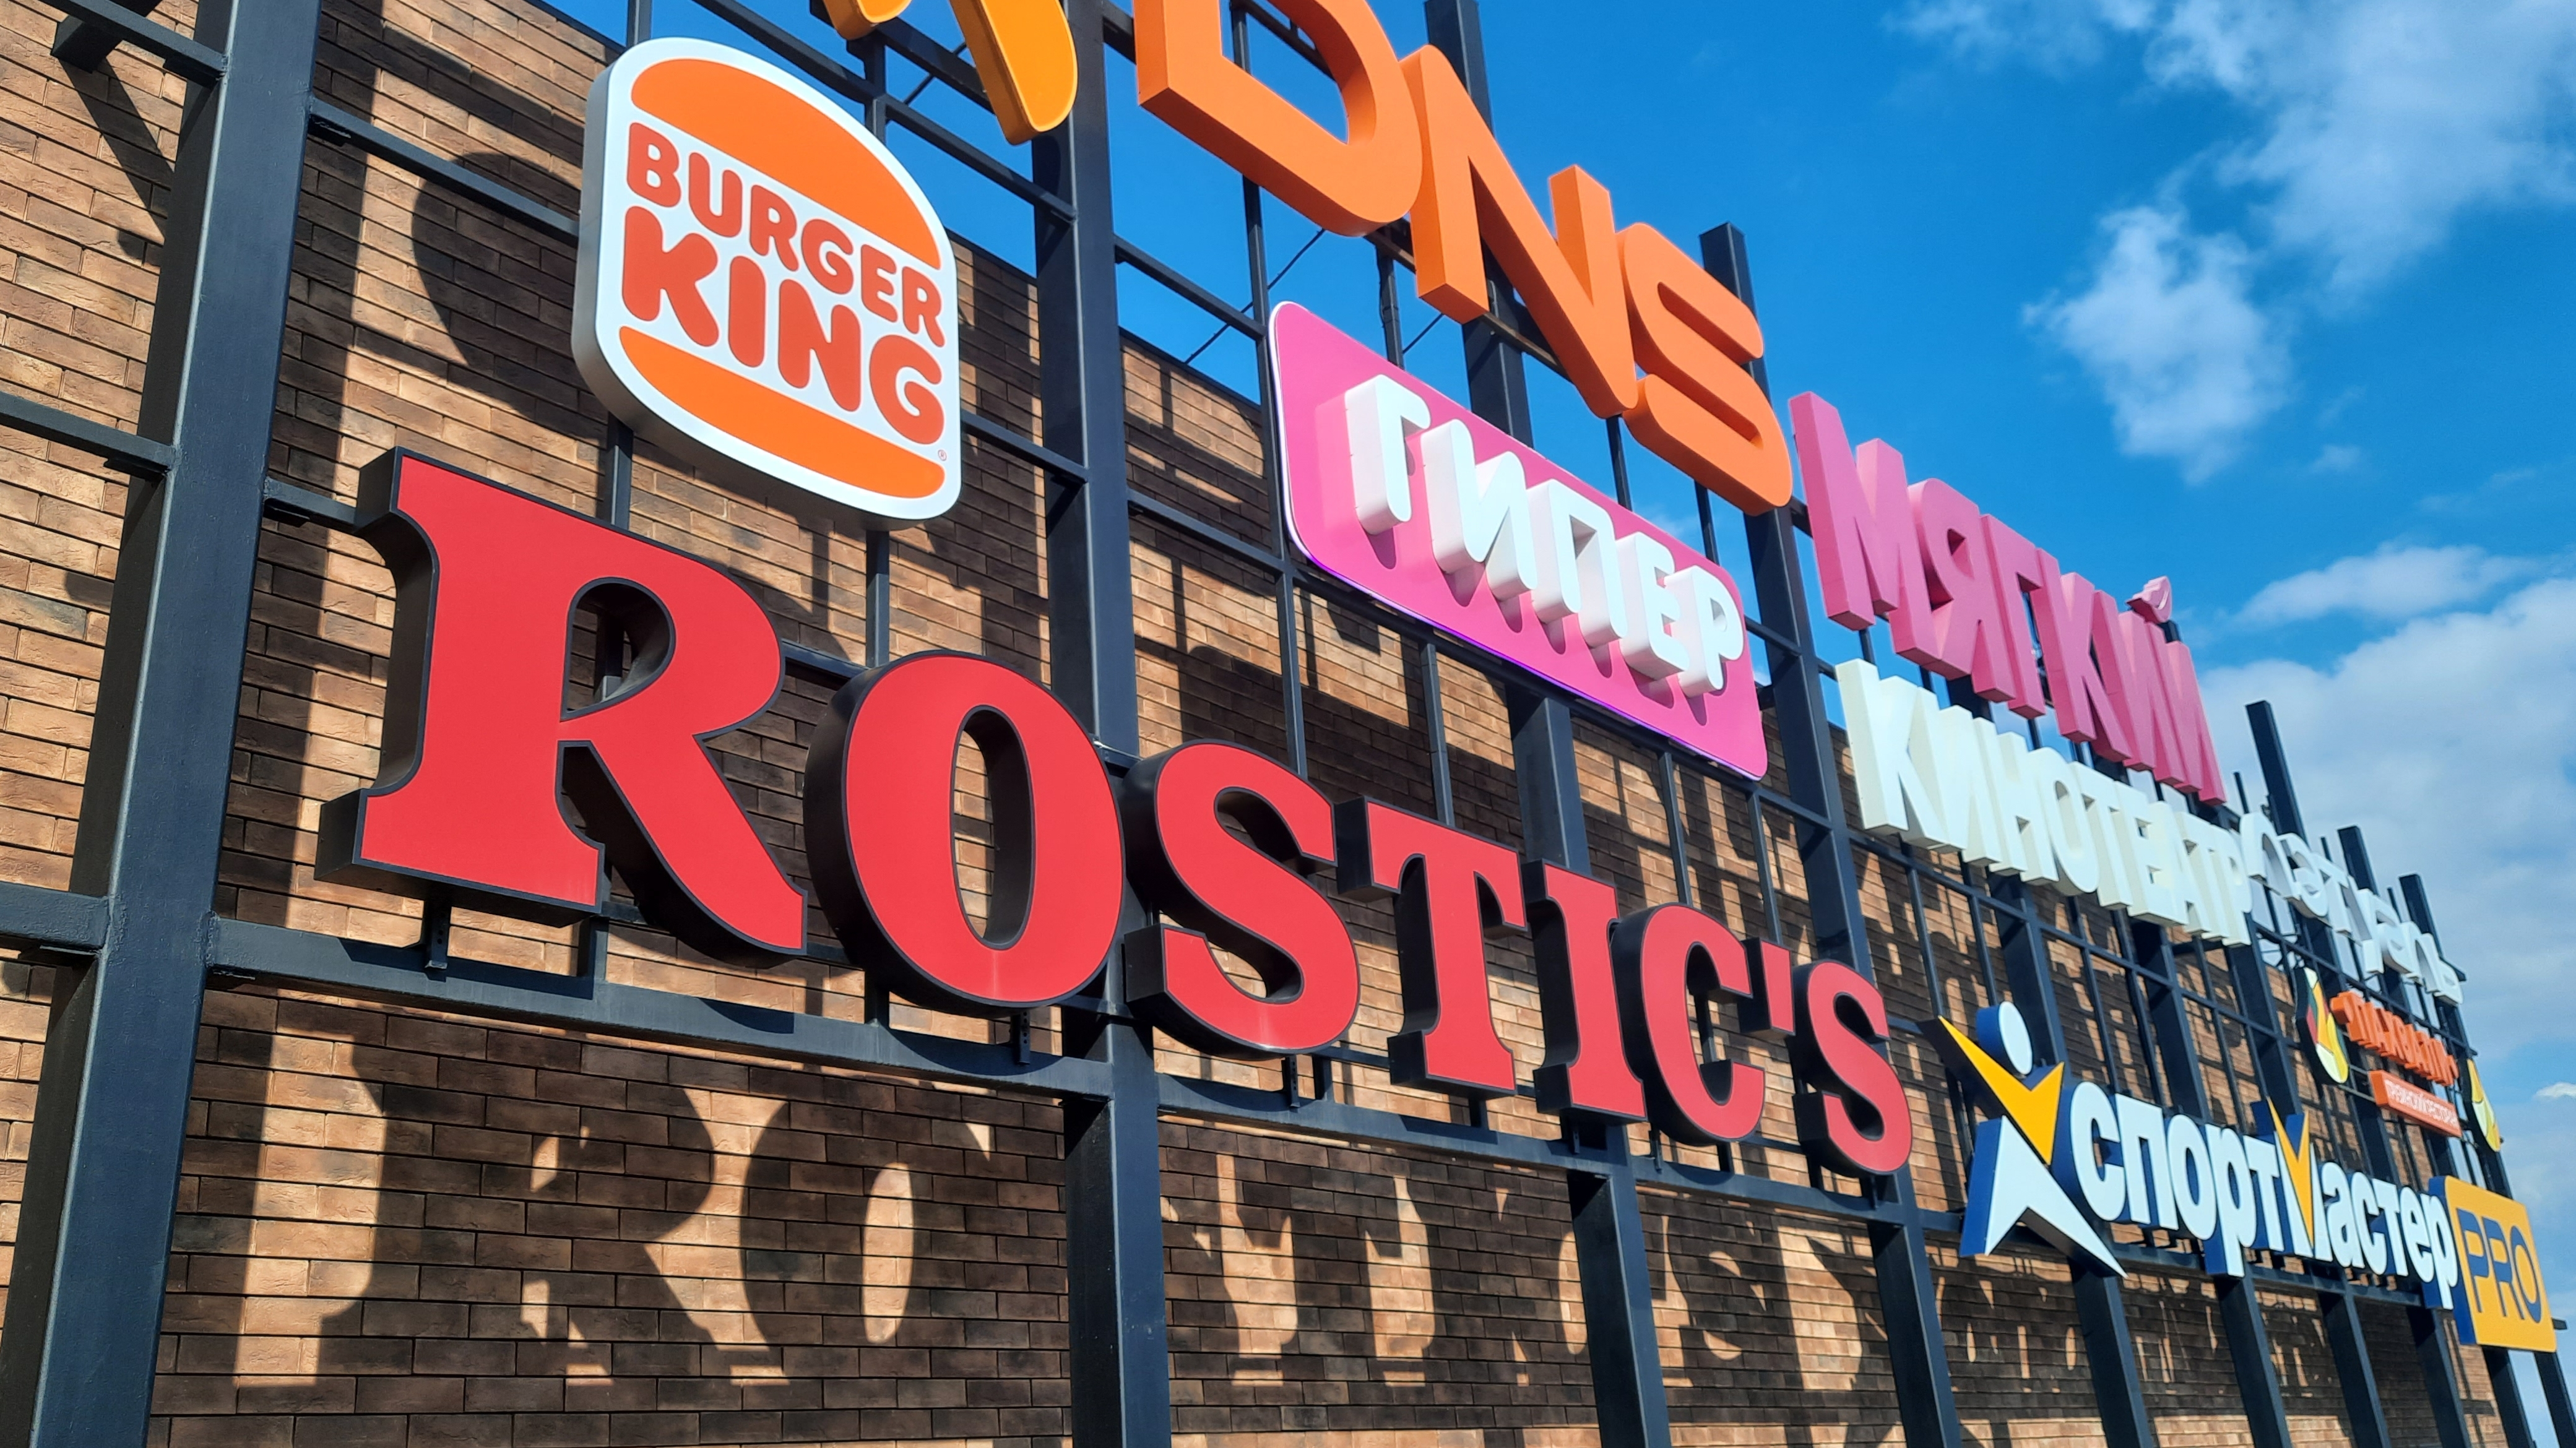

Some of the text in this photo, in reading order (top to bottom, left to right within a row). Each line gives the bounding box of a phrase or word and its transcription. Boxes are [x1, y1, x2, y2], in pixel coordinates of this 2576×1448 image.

[622, 205, 944, 445] KING
[626, 121, 945, 347] BURGER
[1344, 374, 1744, 697] ГИПЕР
[1789, 391, 2226, 806] МЯГКИЙ
[316, 446, 1913, 1177] ROSTIC'S
[1836, 658, 2252, 947] КИНОТЕАТР
[2455, 1207, 2543, 1324] PRO
